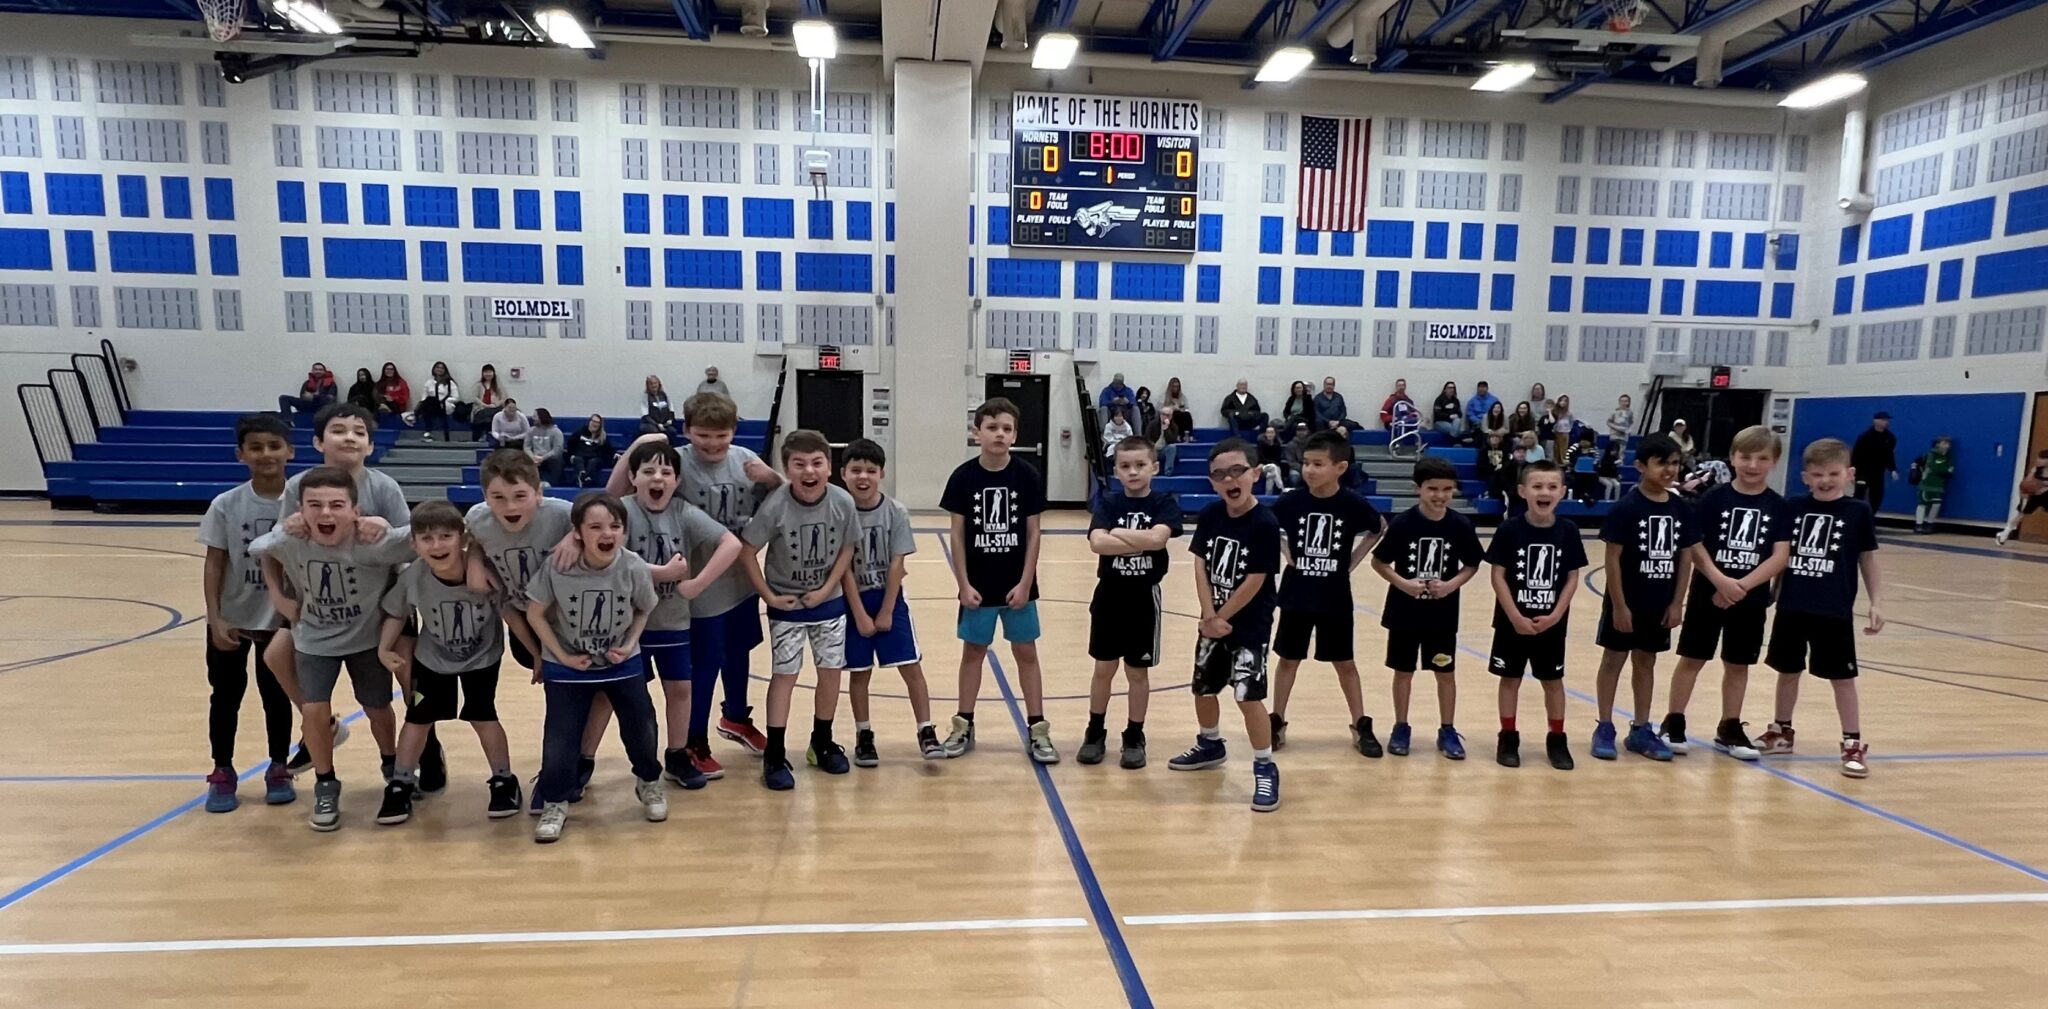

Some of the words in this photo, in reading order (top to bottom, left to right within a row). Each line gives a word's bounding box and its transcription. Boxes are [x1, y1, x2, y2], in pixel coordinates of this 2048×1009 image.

[1069, 97, 1087, 126] OF
[1094, 98, 1121, 128] THE
[1130, 101, 1198, 131] HORNETS
[1022, 131, 1059, 143] HORNETS
[1157, 136, 1191, 149] VISITOR
[1090, 132, 1140, 159] 8:00
[1043, 145, 1059, 172] 0
[1176, 151, 1192, 177] 0
[1048, 192, 1068, 201] TEAM
[1146, 196, 1165, 205] TEAM
[1046, 201, 1069, 210] FOULS
[1143, 205, 1166, 214] FOULS
[1016, 214, 1045, 224] PLAYER
[1048, 215, 1072, 225] FOULS
[1142, 218, 1170, 229] PLAYER
[1172, 220, 1196, 230] FOULS
[494, 299, 571, 318] HOLMDEL
[1429, 323, 1494, 340] HOLMDEL
[974, 533, 1019, 548] ALL-STAR
[1639, 560, 1675, 573] ALL-STA
[1517, 589, 1556, 604] ALL-STA
[307, 604, 362, 621] ALL-STAR
